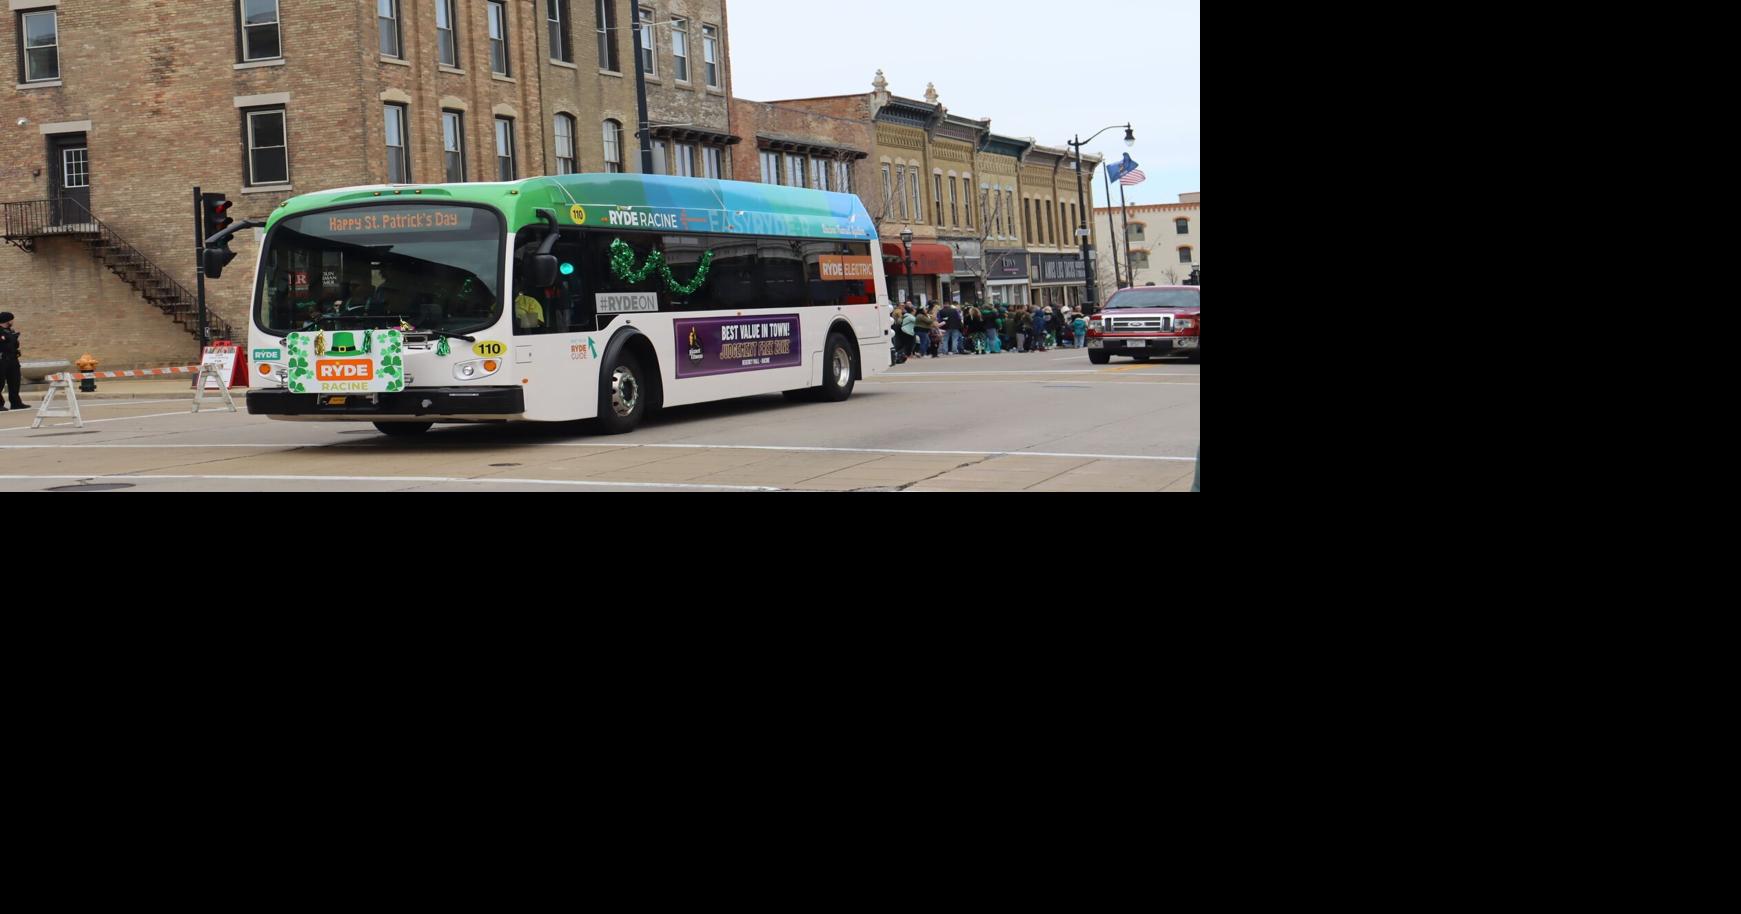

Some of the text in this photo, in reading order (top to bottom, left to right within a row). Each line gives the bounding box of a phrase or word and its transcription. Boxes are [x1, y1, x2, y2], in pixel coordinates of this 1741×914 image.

[329, 211, 458, 231] Happy St. Patrick's Day
[573, 209, 584, 220] 110
[609, 210, 678, 228] RYDE RACINE
[822, 261, 844, 276] RYDE
[600, 295, 656, 311] #RYDEON
[721, 322, 790, 341] BEST VALUE IN TOWN!
[478, 343, 501, 354] 110
[570, 344, 587, 353] RYDE
[758, 340, 774, 357] FREE
[774, 338, 791, 355] ZONE
[254, 350, 278, 361] RYDE
[320, 364, 368, 379] RYDE
[321, 382, 369, 393] RACINE
